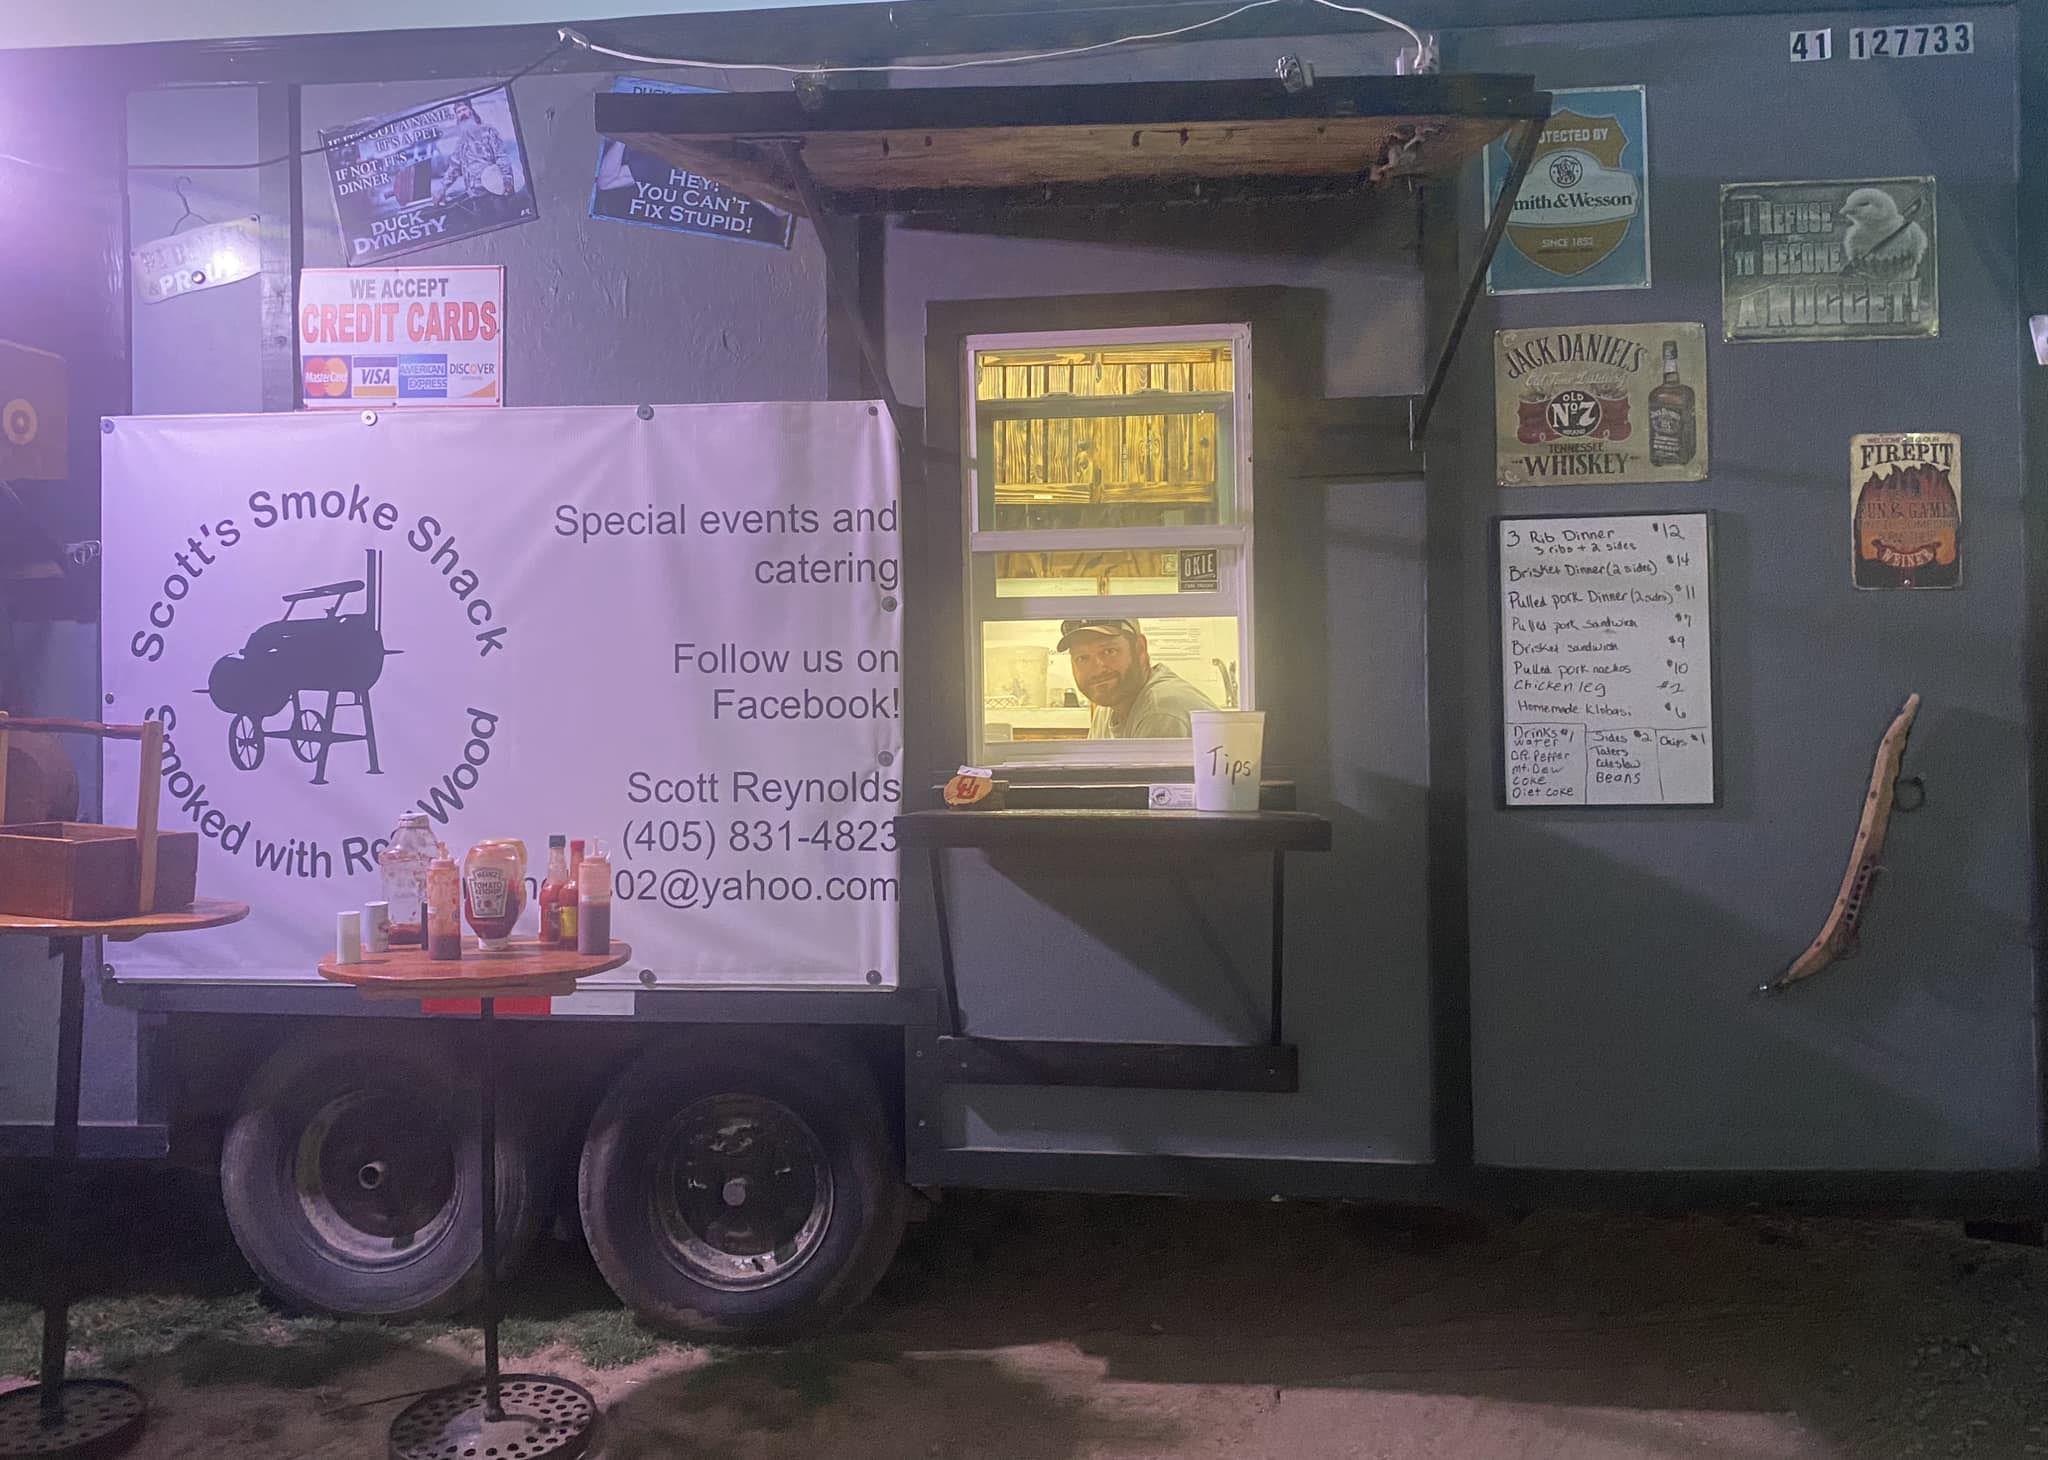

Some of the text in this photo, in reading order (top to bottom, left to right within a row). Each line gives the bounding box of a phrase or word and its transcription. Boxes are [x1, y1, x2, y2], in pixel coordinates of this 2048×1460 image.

[1791, 24, 1970, 59] 41 127733
[1593, 127, 1609, 142] BY
[335, 168, 348, 182] IF
[349, 159, 383, 179] NOT,
[668, 168, 720, 192] HEY:
[636, 182, 750, 215] YOU CAN'T
[371, 210, 425, 236] DUCK
[629, 199, 753, 234] FIX STUPID!
[1758, 201, 1834, 235] REFUSE
[352, 215, 447, 255] DYNASTY
[1761, 240, 1842, 275] BECOME
[349, 277, 449, 300] WE ACCEPT
[1735, 280, 1922, 328] A NUGGET!
[301, 301, 499, 344] CREDIT CARDS
[1504, 333, 1648, 380] JACK DANIEL'S
[360, 368, 391, 385] VISA
[399, 363, 445, 376] AMERICAN
[449, 363, 495, 375] DISCOVER
[407, 378, 448, 390] EXPRESS
[1562, 391, 1585, 402] OLD
[1522, 452, 1631, 477] WHISKEY
[1860, 442, 1954, 470] FIREPIT
[553, 500, 899, 545] Special events and
[1506, 530, 1521, 547] 3
[1529, 530, 1555, 544] Rib
[1562, 529, 1615, 542] Dinner
[1534, 546, 1544, 555] 3
[1549, 544, 1574, 554] ribs
[1591, 542, 1601, 552] 2
[1606, 541, 1637, 551] sides
[131, 483, 508, 662] Scott's Smoke Shack
[754, 551, 900, 591] catering
[1184, 553, 1214, 577] OKIE
[1509, 565, 1561, 582] Brisket
[1508, 591, 1547, 609] Pulled
[1552, 592, 1584, 610] pork
[1512, 616, 1547, 632] Pulled
[1553, 619, 1580, 634] pork
[673, 642, 900, 674] Follow us on
[1512, 640, 1559, 656] Brisket
[1513, 660, 1553, 676] Pulled
[1558, 663, 1589, 679] pork
[1592, 663, 1632, 674] nachos
[1513, 679, 1573, 693] Chicken
[1578, 681, 1606, 698] leg
[713, 687, 901, 720] Facebook!
[1517, 700, 1579, 714] Homemade
[1513, 725, 1558, 739] Drinks
[1591, 730, 1628, 744] Sides
[1659, 736, 1688, 748] Chips
[1207, 745, 1251, 779] Tips
[1533, 750, 1570, 762] Pepper
[1532, 764, 1563, 775] Dew
[1595, 771, 1641, 785] Beans
[254, 838, 332, 878] with
[416, 706, 499, 826] Wood
[627, 770, 902, 812] Scott Reynolds
[1512, 787, 1542, 799] Diet
[622, 819, 898, 860] (405) 831-4823
